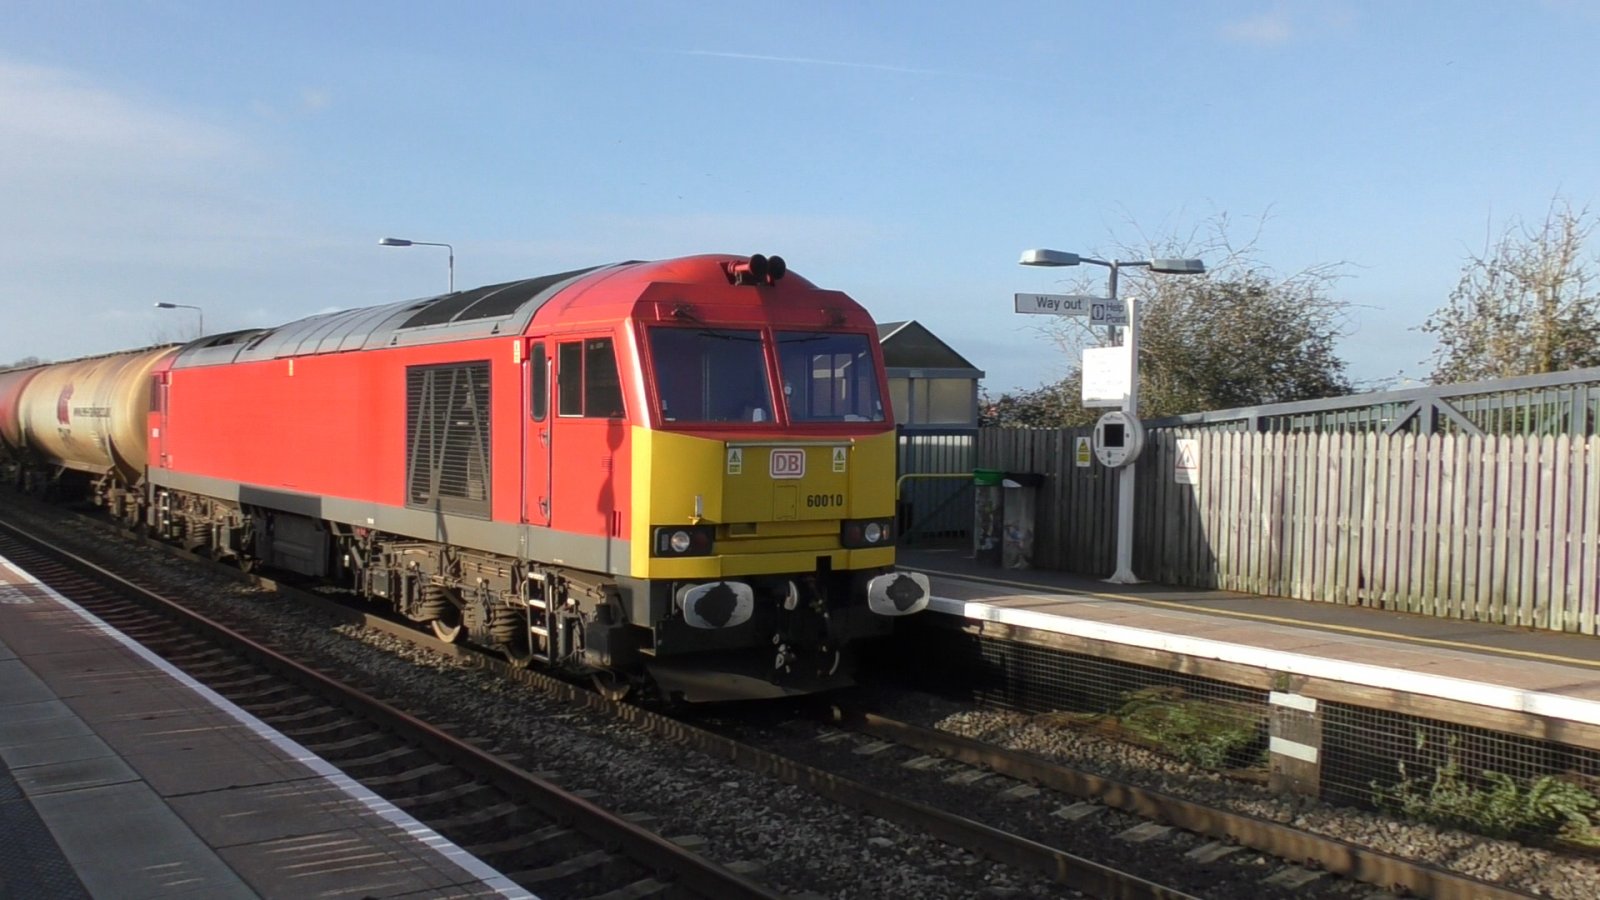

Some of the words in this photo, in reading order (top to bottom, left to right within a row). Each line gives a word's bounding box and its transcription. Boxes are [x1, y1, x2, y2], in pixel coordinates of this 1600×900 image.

[1036, 296, 1060, 311] Way
[1064, 299, 1082, 310] out
[1106, 302, 1124, 313] Help
[1106, 314, 1126, 323] Point
[776, 455, 799, 472] DB
[807, 494, 843, 507] 60010
